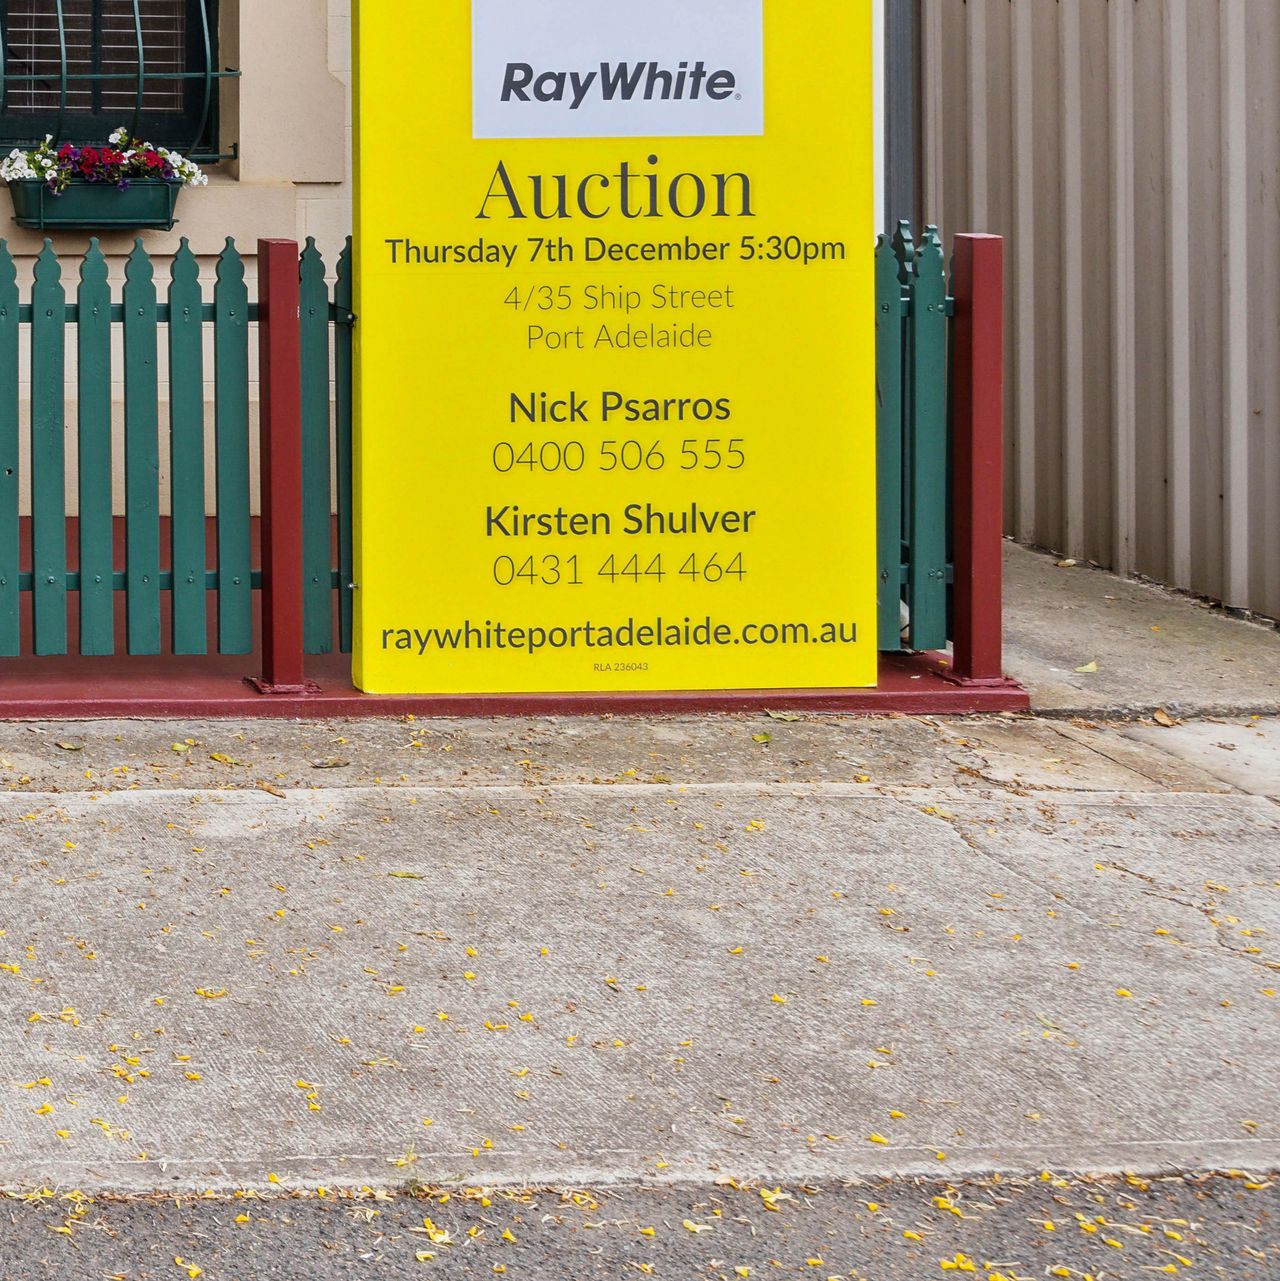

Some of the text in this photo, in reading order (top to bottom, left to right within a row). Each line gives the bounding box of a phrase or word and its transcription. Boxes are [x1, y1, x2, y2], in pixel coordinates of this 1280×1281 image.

[474, 153, 757, 220] Auction
[384, 235, 846, 268] Thursday 7th December 5:30pm
[503, 283, 735, 315] 4/35 Ship Street
[527, 322, 712, 351] Port Adelaide
[510, 390, 731, 423] Nick Psarros
[492, 438, 745, 473] 0400 506 555
[485, 502, 757, 537] Kirsten Shulver
[492, 551, 747, 586] 0431 444 464
[382, 615, 857, 656] raywhiteportadelaide.com.au
[593, 662, 649, 672] RLA 236043
